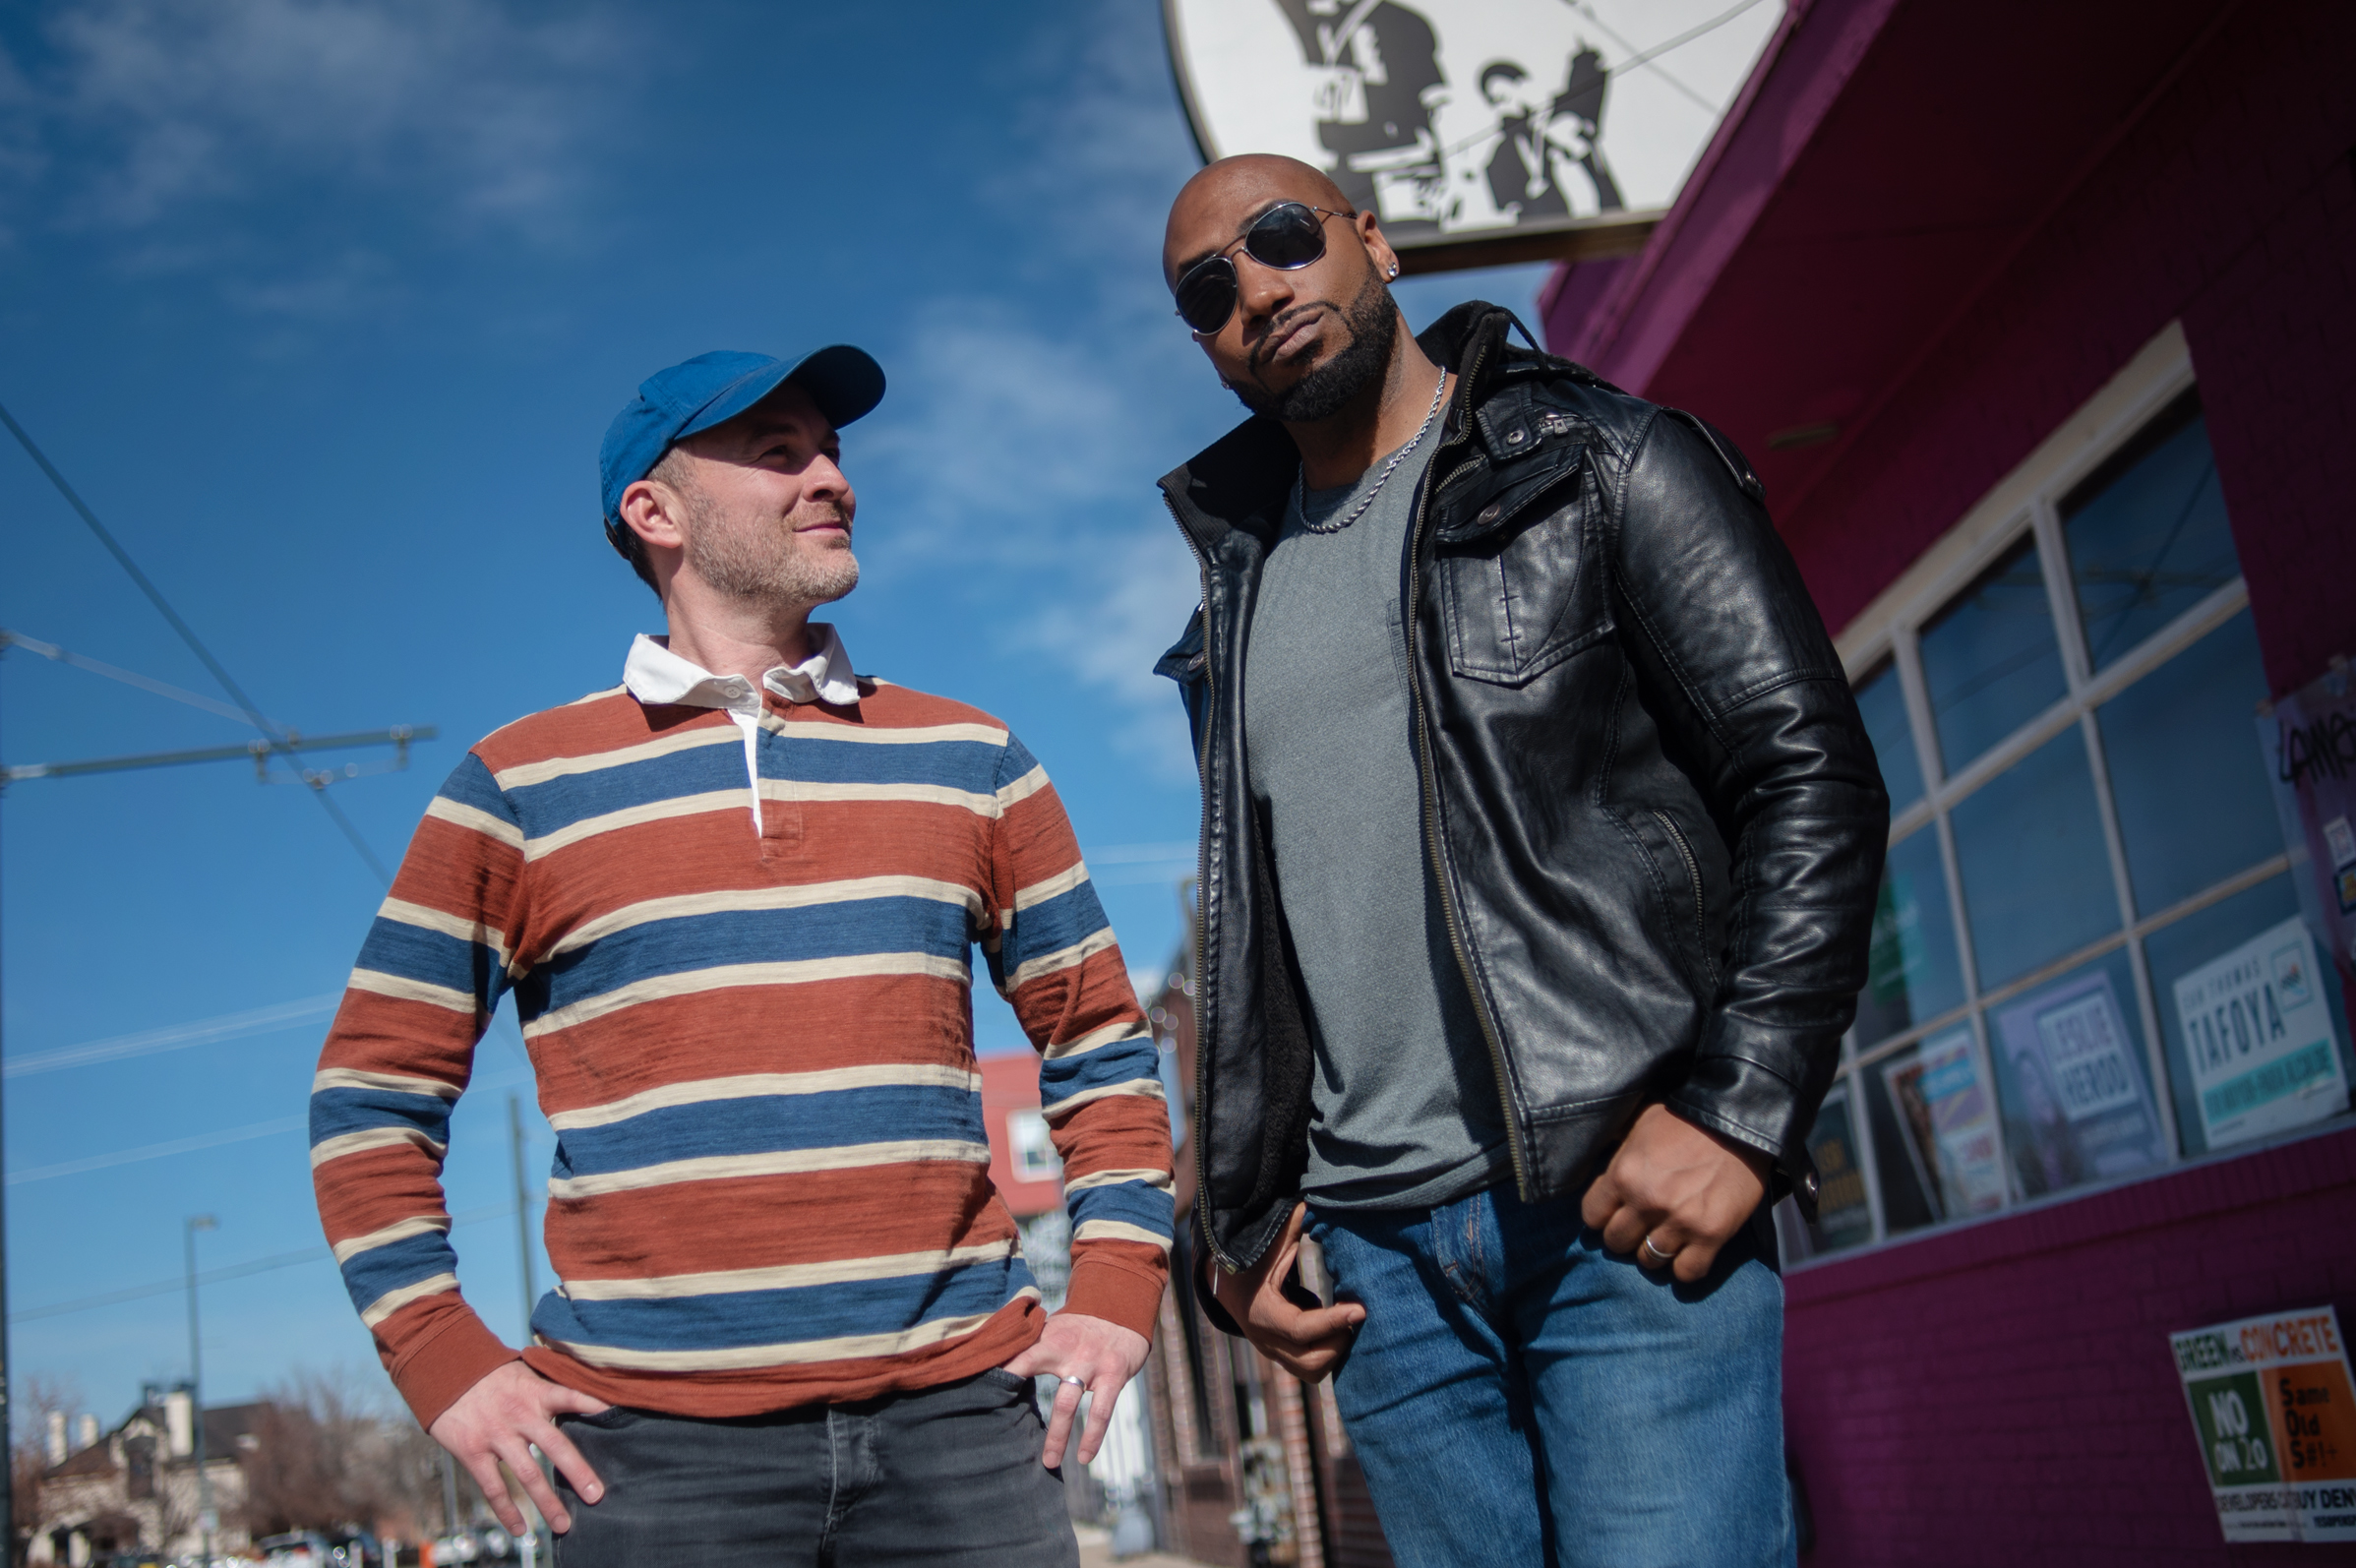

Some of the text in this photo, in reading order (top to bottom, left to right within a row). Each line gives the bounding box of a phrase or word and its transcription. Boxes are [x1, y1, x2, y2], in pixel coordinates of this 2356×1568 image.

[2189, 981, 2287, 1076] TAFOYA
[2061, 1051, 2130, 1107] HEROD
[2174, 1330, 2232, 1372] GREEN
[2240, 1314, 2339, 1362] CONCRETE
[2207, 1389, 2250, 1439] NO
[2278, 1376, 2330, 1407] Same
[2284, 1408, 2322, 1437] Old
[2213, 1439, 2243, 1474] ON
